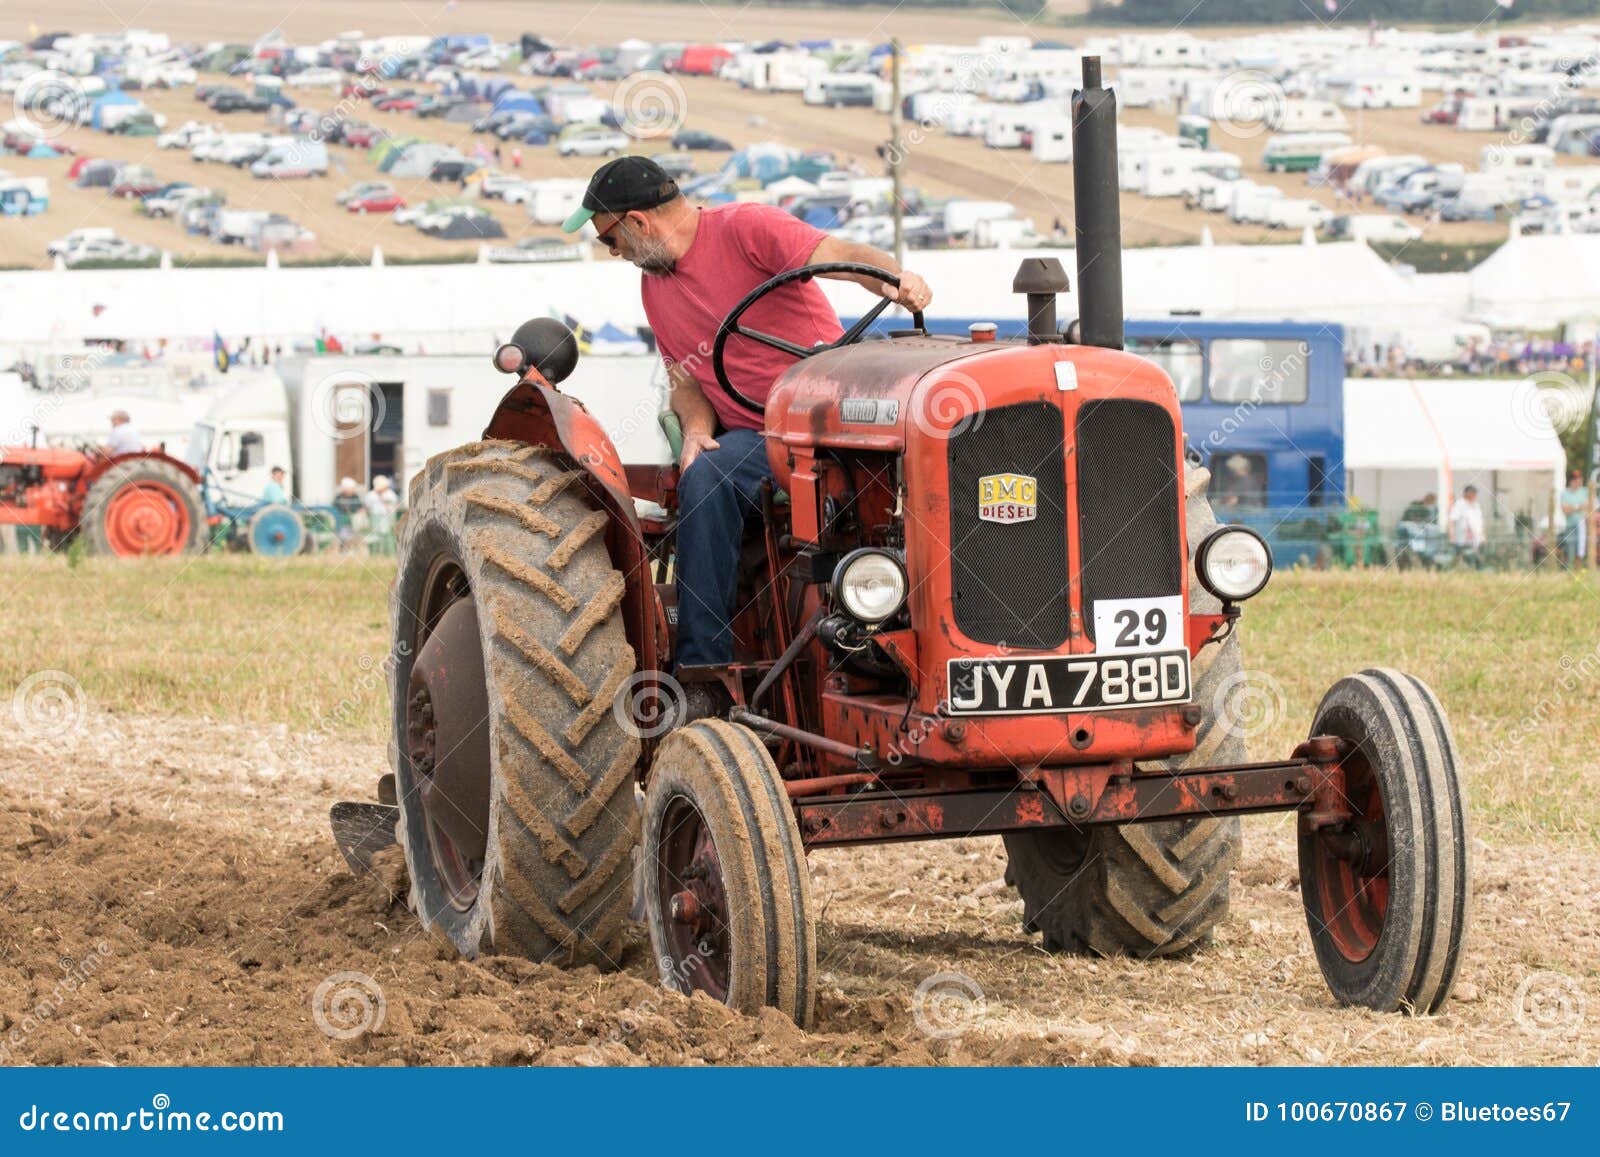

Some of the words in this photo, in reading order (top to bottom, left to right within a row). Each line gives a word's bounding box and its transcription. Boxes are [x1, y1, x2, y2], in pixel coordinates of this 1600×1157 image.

[983, 478, 1033, 501] BMC
[982, 505, 1033, 519] DIESEL
[1114, 608, 1167, 648] 29
[952, 663, 1053, 709] JYA
[1067, 655, 1187, 707] 788D
